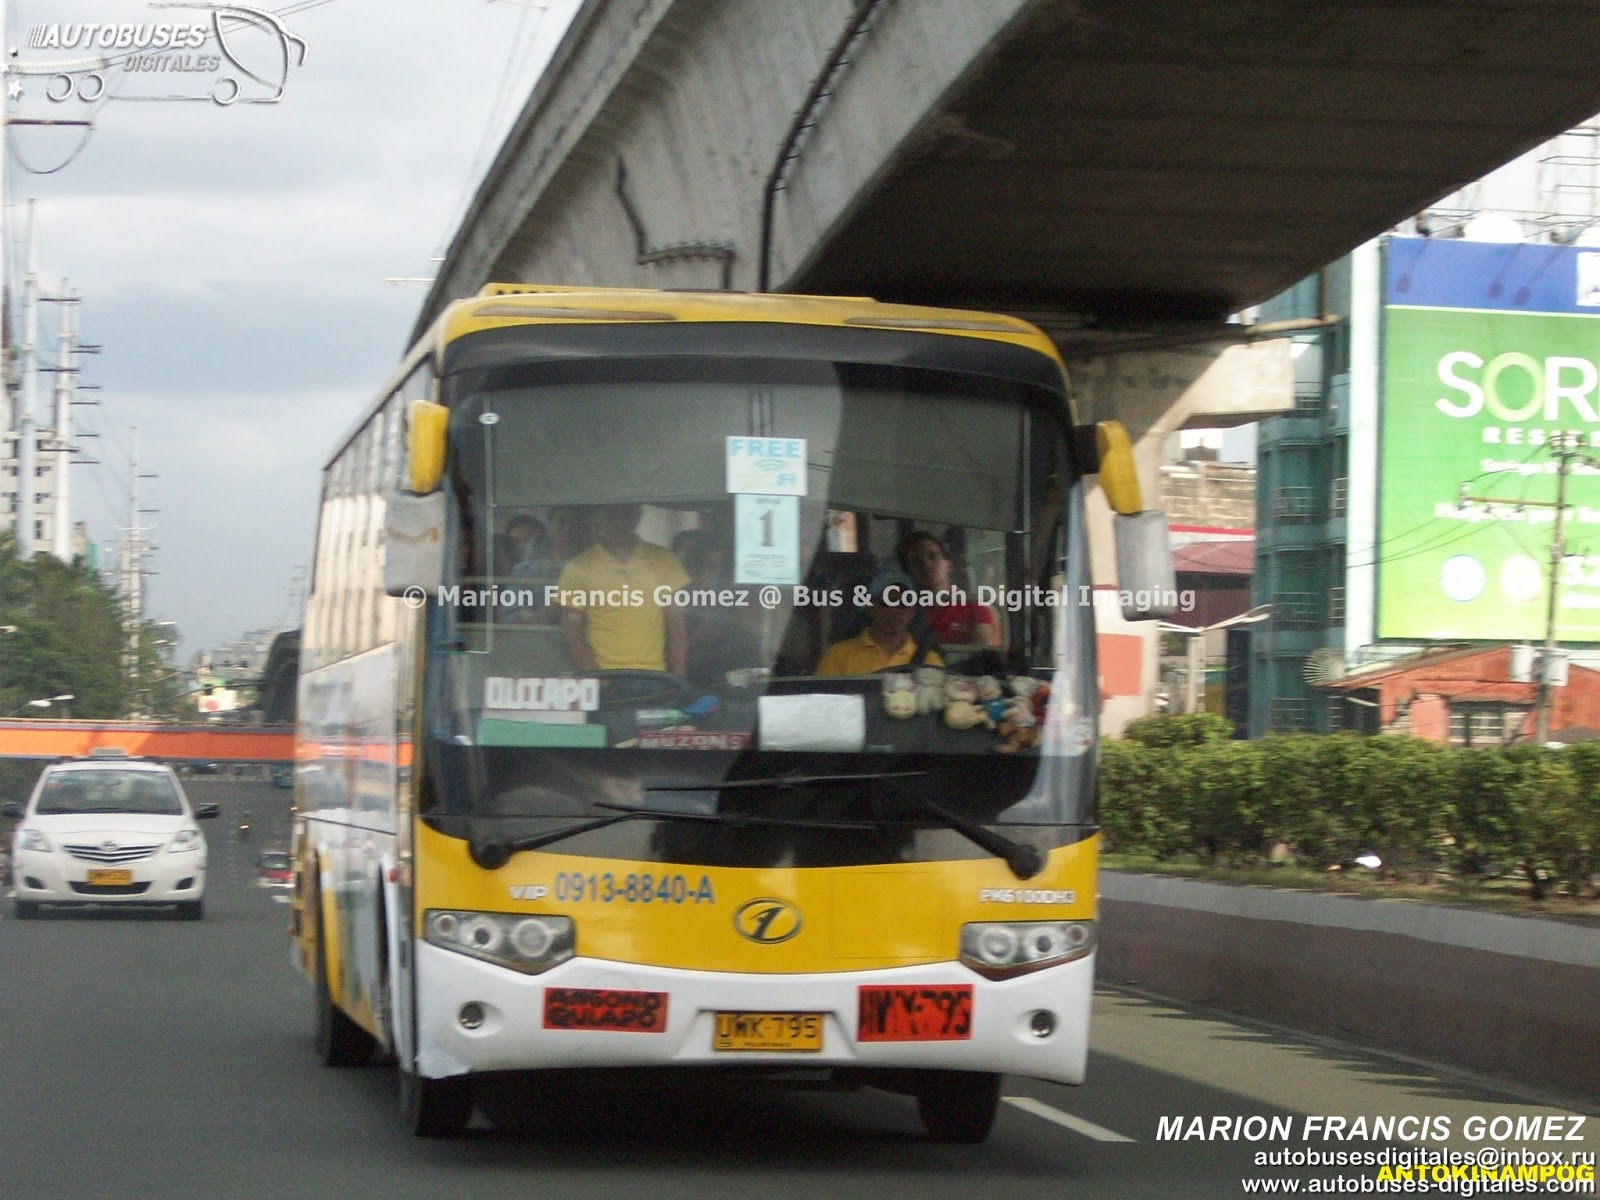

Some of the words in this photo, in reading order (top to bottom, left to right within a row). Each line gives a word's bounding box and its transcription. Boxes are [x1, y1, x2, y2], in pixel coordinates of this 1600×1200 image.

[1435, 351, 1600, 422] SOR
[729, 438, 803, 457] FREE
[757, 509, 776, 547] 1
[508, 885, 549, 900] VIP
[554, 871, 715, 904] 0913-8840-A
